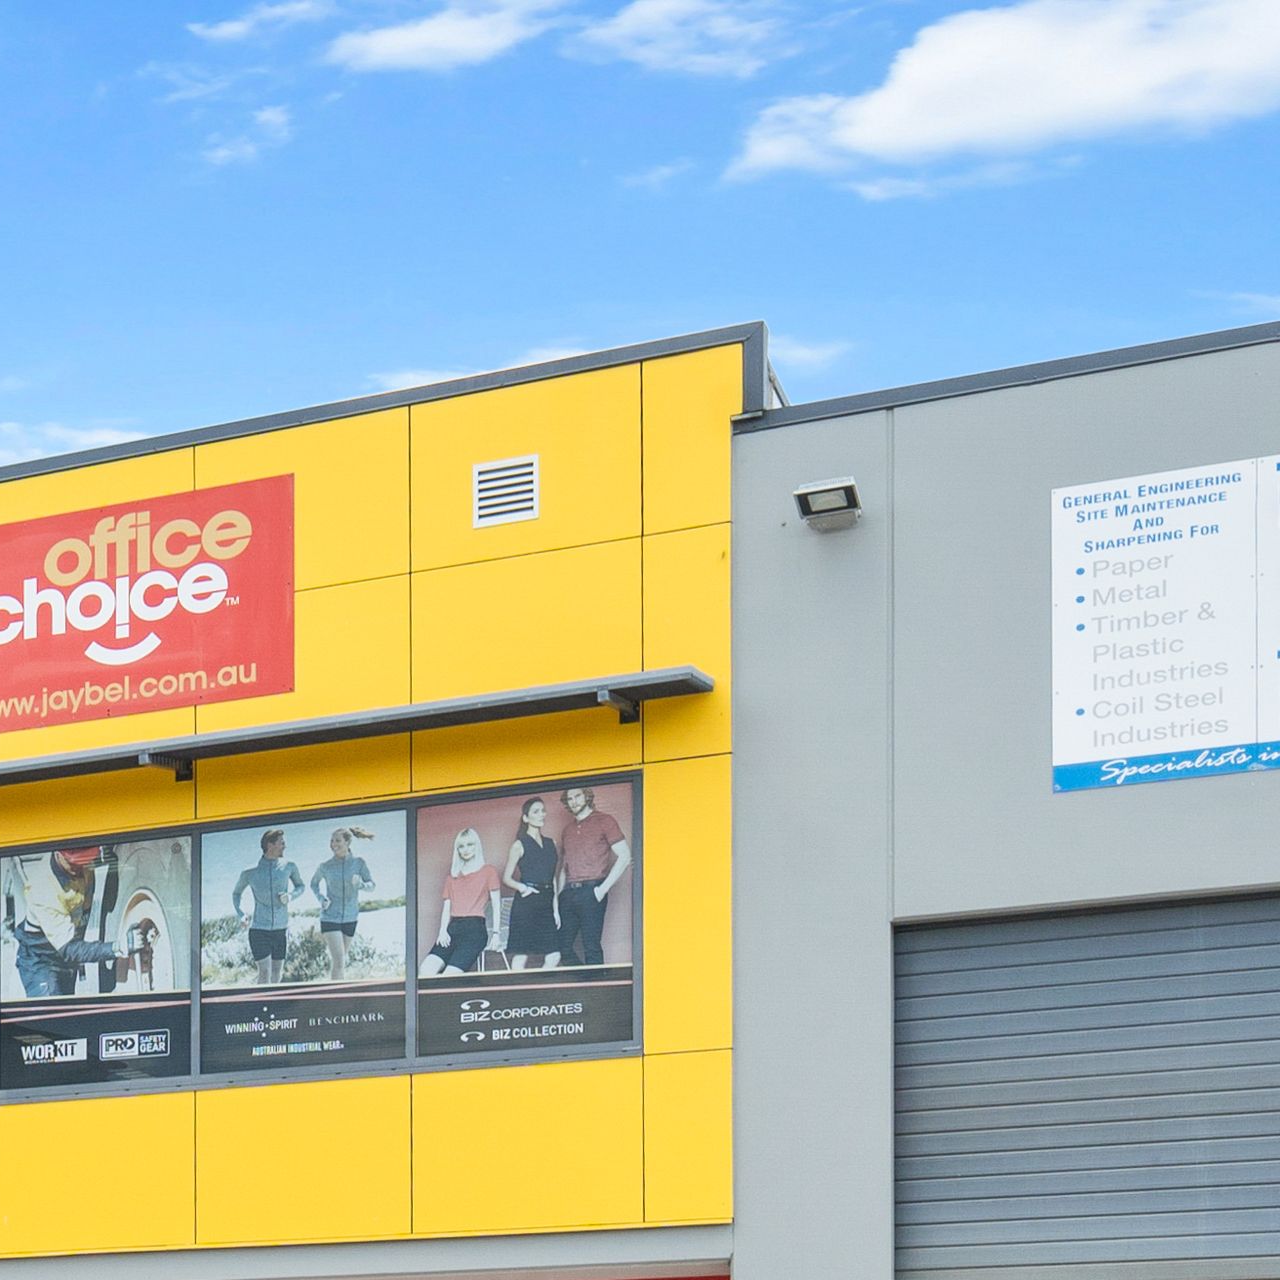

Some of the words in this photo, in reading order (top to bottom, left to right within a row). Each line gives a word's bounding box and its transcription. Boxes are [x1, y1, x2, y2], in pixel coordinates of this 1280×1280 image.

[44, 509, 253, 587] office
[1092, 555, 1174, 579] Paper
[1092, 580, 1167, 607] Metal
[1091, 606, 1189, 635] Timber
[1197, 601, 1216, 621] &
[1092, 637, 1185, 664] Plastic
[1092, 660, 1229, 691] Industries
[1092, 696, 1144, 720] Coil
[1154, 687, 1224, 713] Steel
[1093, 717, 1229, 748] Industries
[1100, 747, 1252, 785] Specialists
[309, 1012, 384, 1027] BENCHMARK
[460, 1009, 490, 1024] BIZ
[491, 1001, 583, 1020] CORPORATES
[140, 1034, 166, 1042] SAFETY
[225, 1022, 264, 1034] WINNING
[269, 1018, 298, 1031] SPIRIT
[492, 1028, 511, 1041] BIZ
[512, 1022, 584, 1039] COLLECTION
[105, 1038, 135, 1052] PRO
[140, 1042, 166, 1053] GEAR
